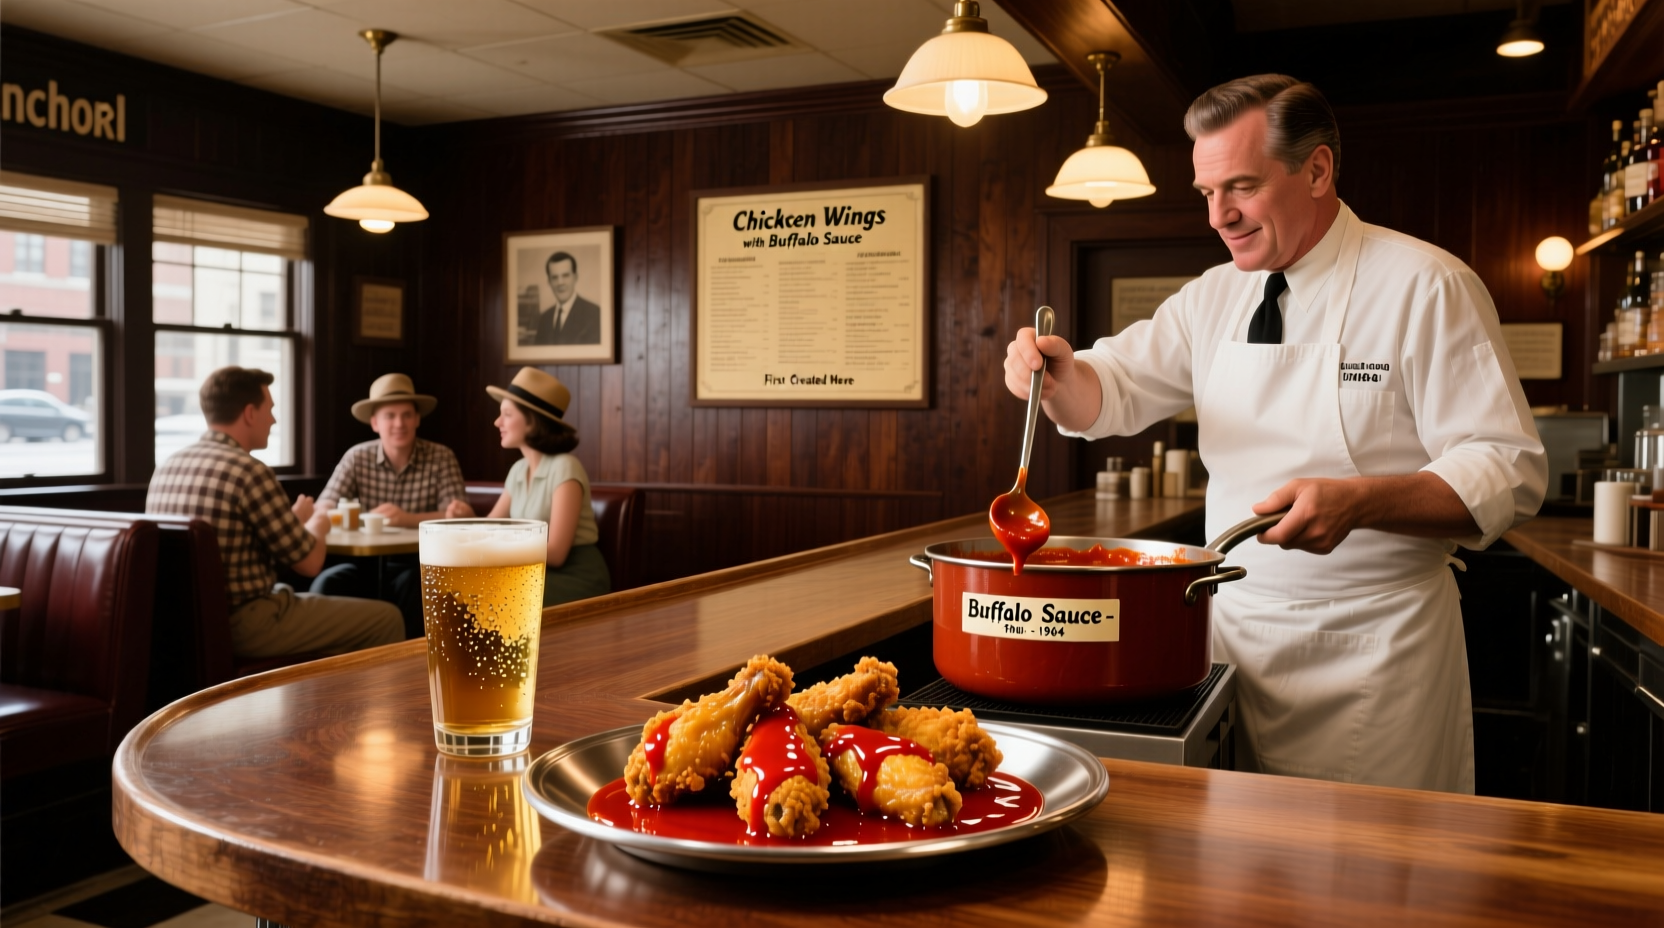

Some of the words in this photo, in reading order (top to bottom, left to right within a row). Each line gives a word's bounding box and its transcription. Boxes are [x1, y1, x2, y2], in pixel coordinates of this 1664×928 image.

[823, 205, 886, 231] Wings
[768, 232, 819, 249] Buffalo
[823, 232, 862, 245] Sauce
[968, 598, 1032, 623] Buffalo
[1042, 603, 1102, 624] Sauce
